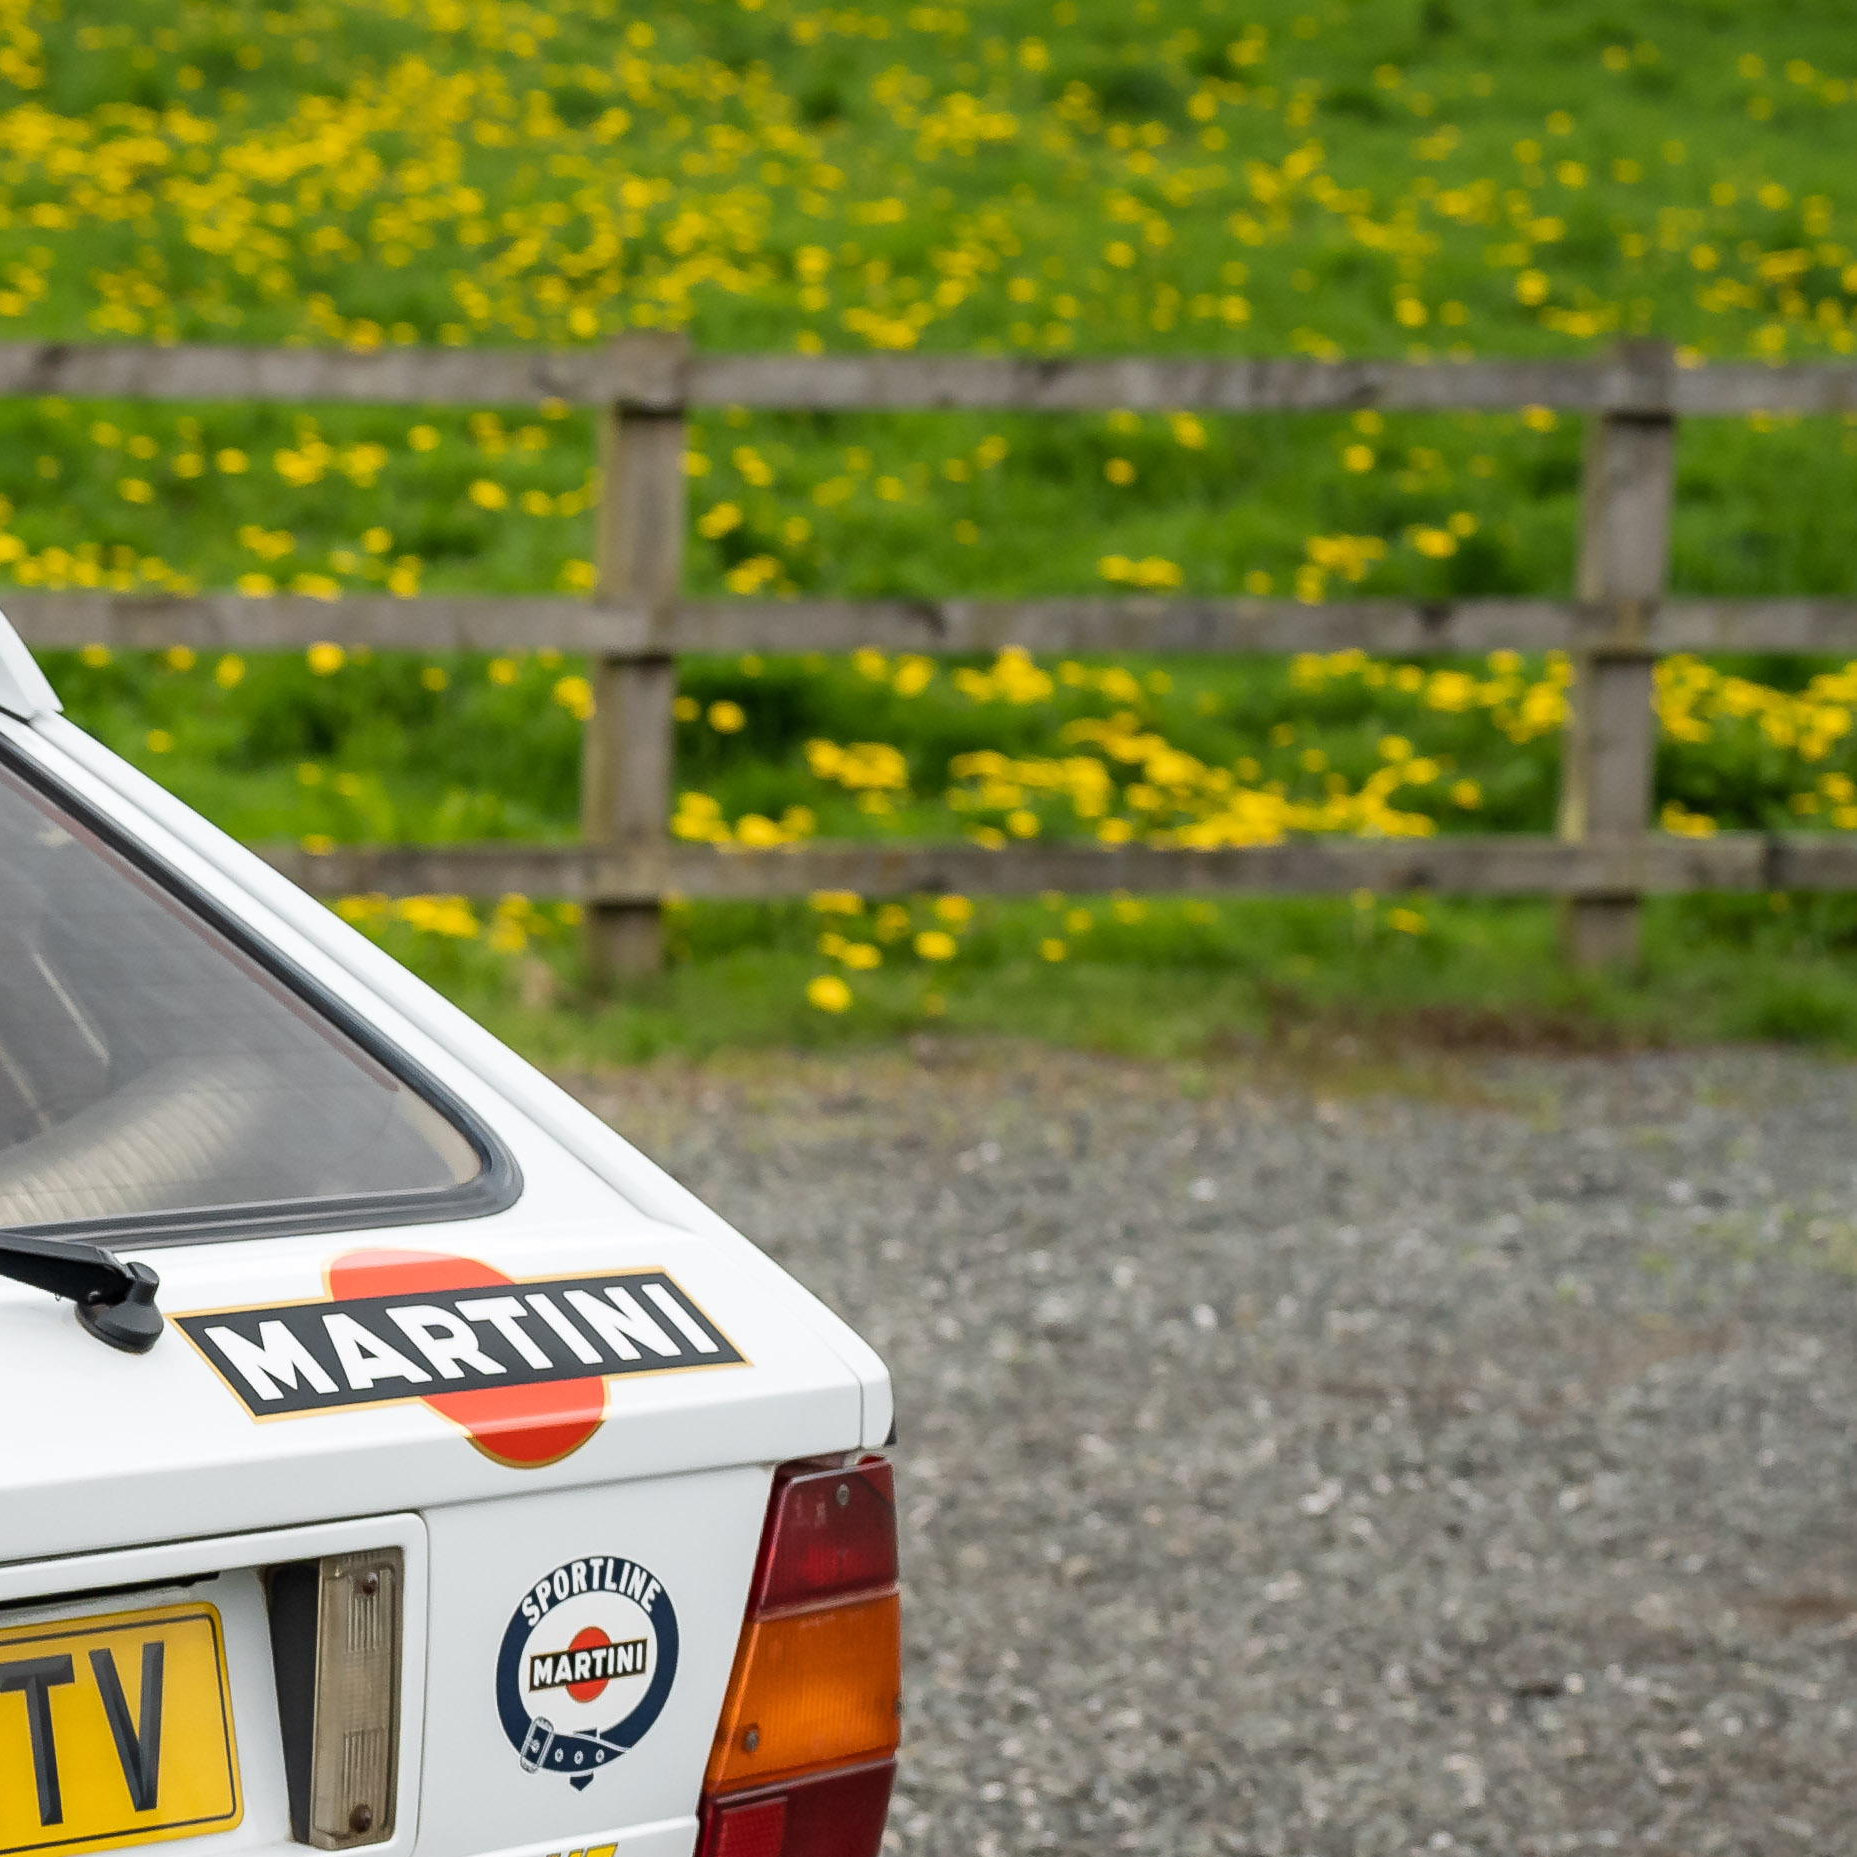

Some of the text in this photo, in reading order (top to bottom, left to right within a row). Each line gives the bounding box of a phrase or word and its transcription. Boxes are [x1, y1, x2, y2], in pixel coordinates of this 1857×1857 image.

[203, 1283, 720, 1401] MARTINI
[521, 1557, 662, 1628] SPORTLINE
[533, 1642, 644, 1688] MARTINI
